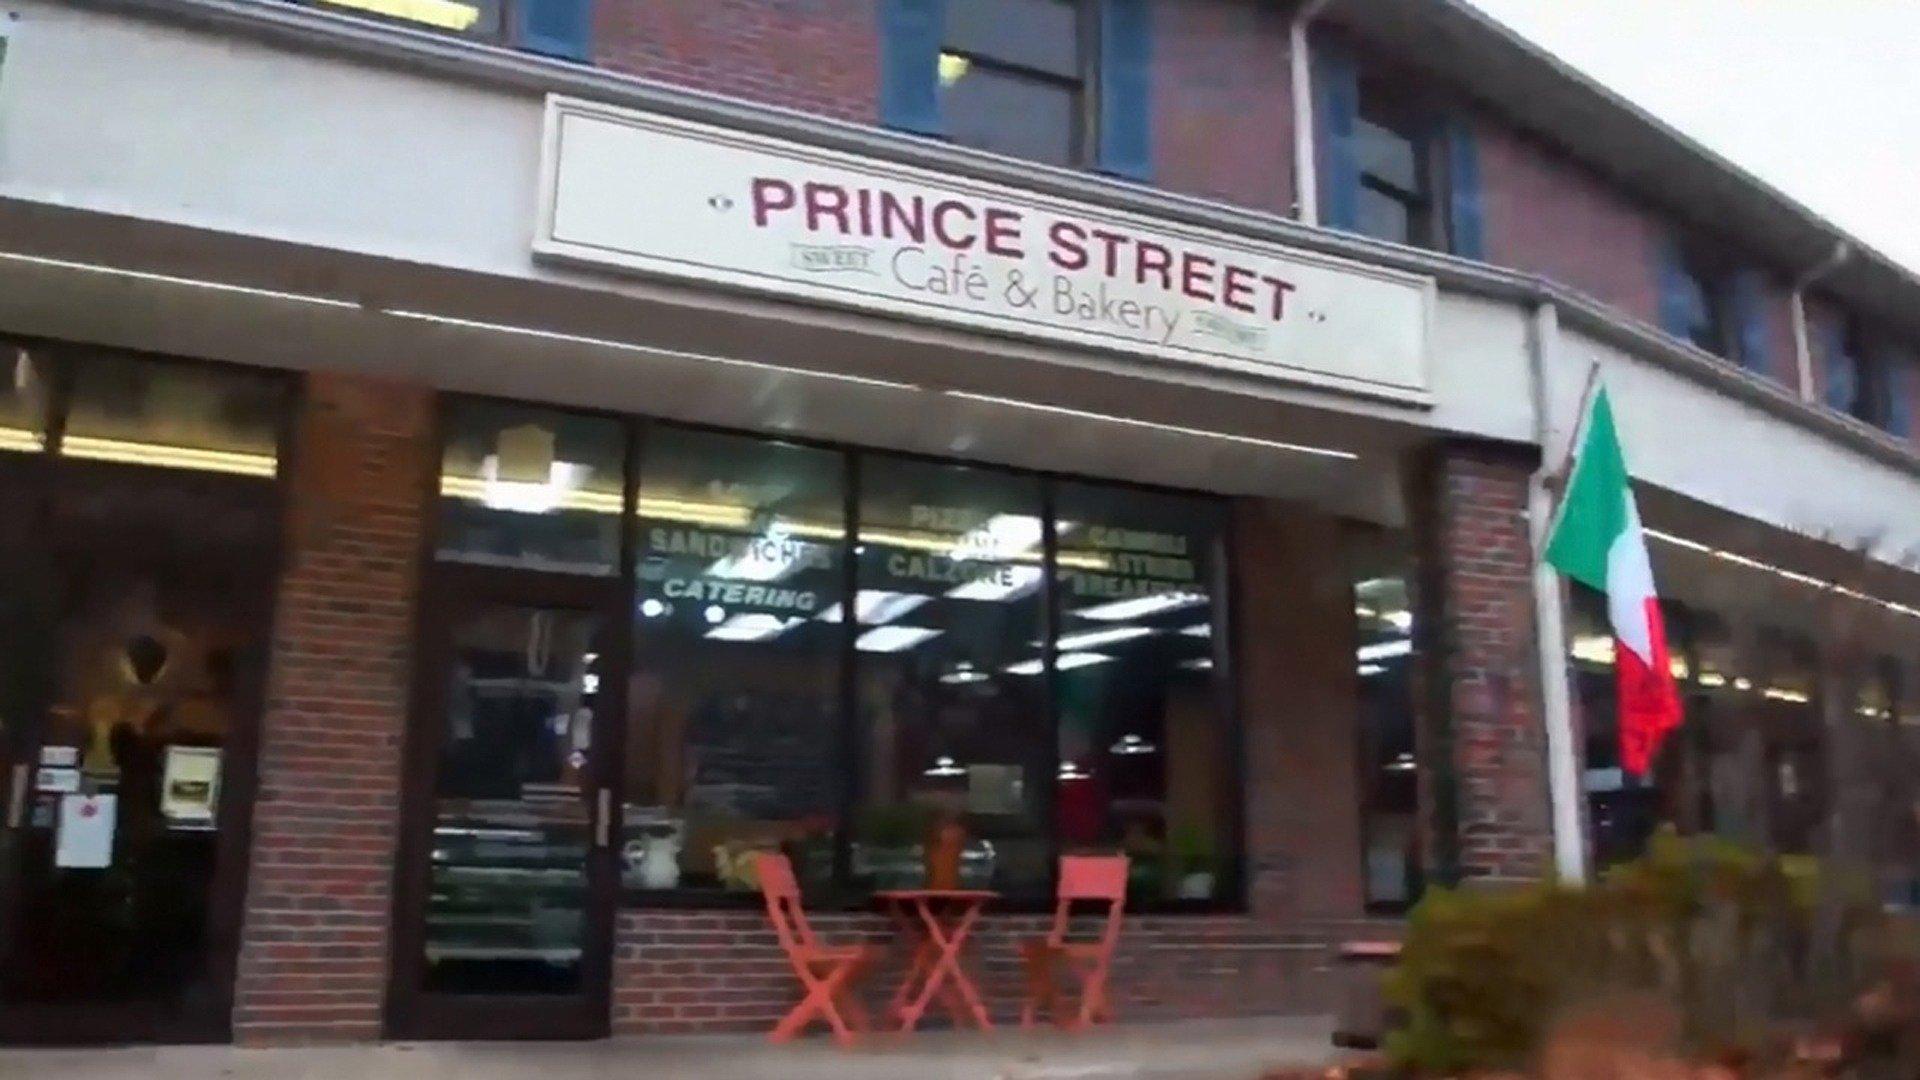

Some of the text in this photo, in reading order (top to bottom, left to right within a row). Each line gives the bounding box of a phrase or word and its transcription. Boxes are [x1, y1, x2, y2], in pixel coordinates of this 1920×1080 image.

[752, 177, 1296, 321] PRINCE STREET
[801, 249, 870, 272] SWEET
[891, 246, 987, 301] Café
[1003, 267, 1038, 309] &
[1052, 274, 1181, 346] Bakery
[662, 577, 818, 611] CATERING
